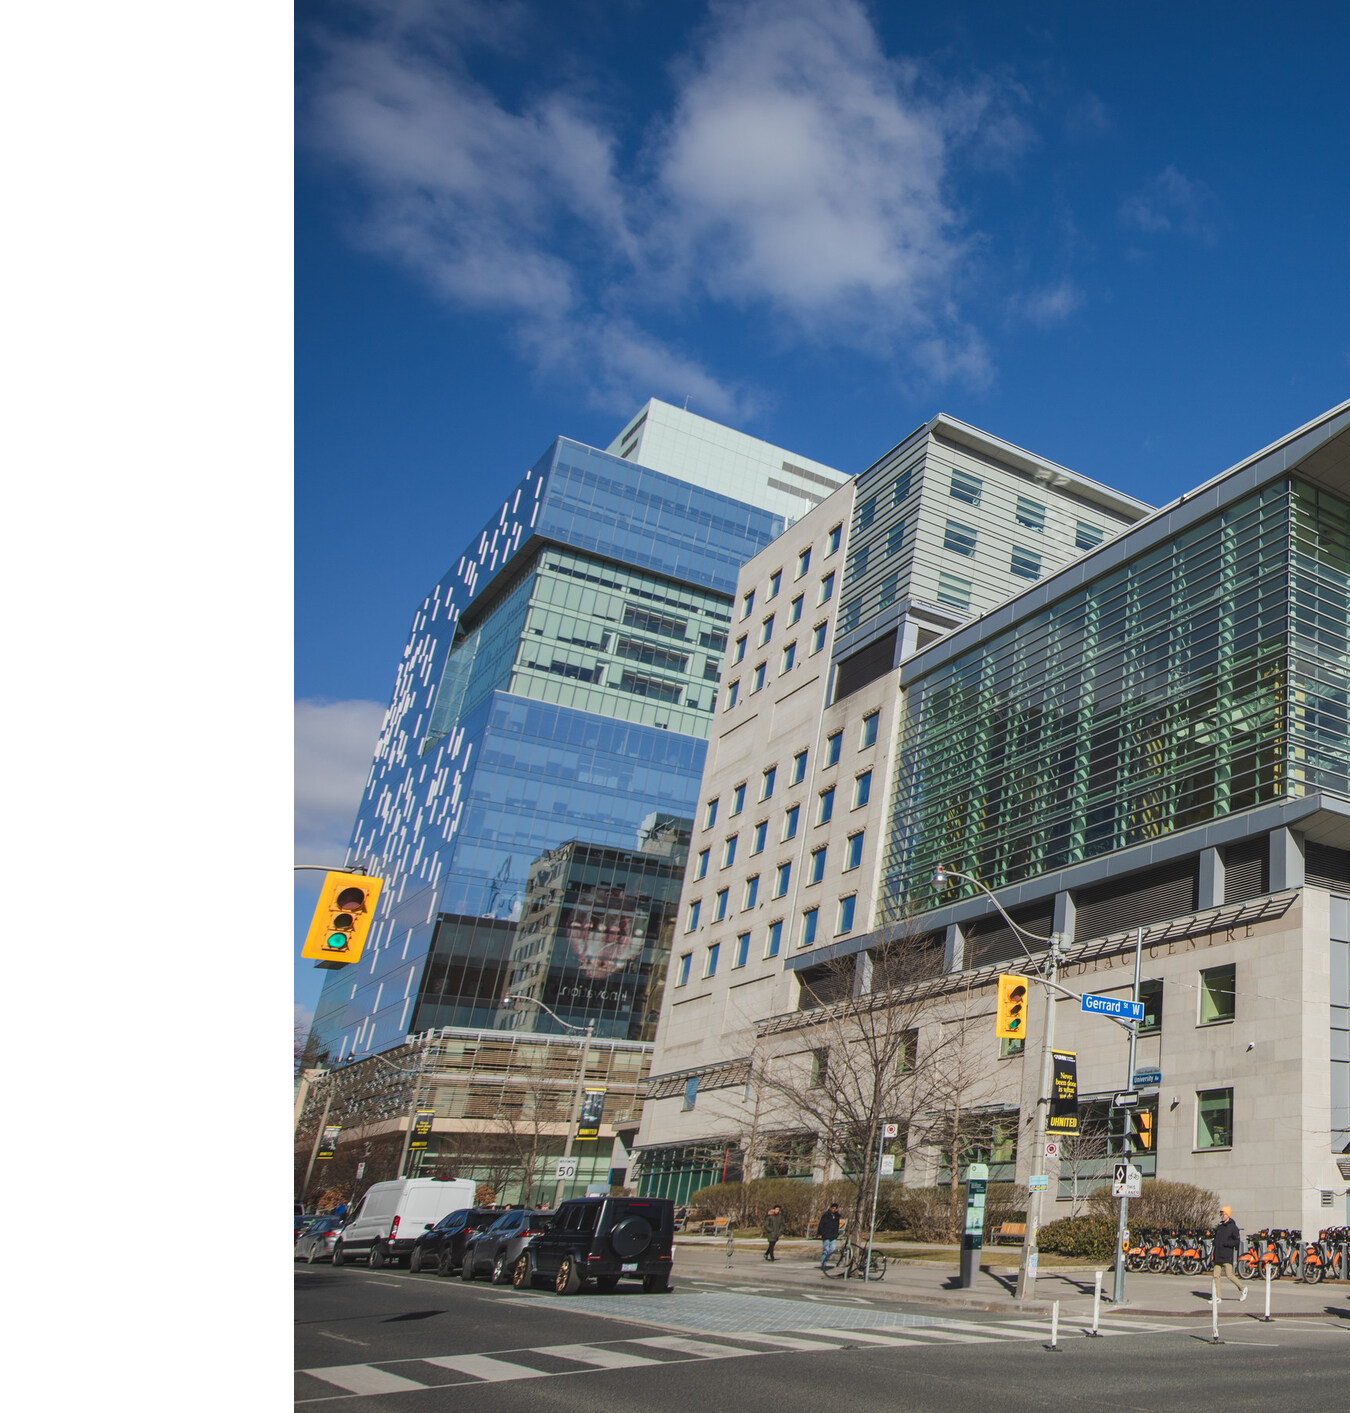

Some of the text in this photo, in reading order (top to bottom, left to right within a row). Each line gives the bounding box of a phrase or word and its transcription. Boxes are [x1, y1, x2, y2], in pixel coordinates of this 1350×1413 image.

[1149, 920, 1255, 959] CENTRE
[1086, 996, 1121, 1013] Gerrard
[1132, 1003, 1141, 1016] W
[1060, 1071, 1073, 1080] Never
[1133, 1074, 1153, 1084] University
[1055, 1077, 1077, 1088] been done
[1063, 1086, 1075, 1094] what
[1050, 1116, 1078, 1128] UHNITED
[558, 1166, 575, 1177] 50
